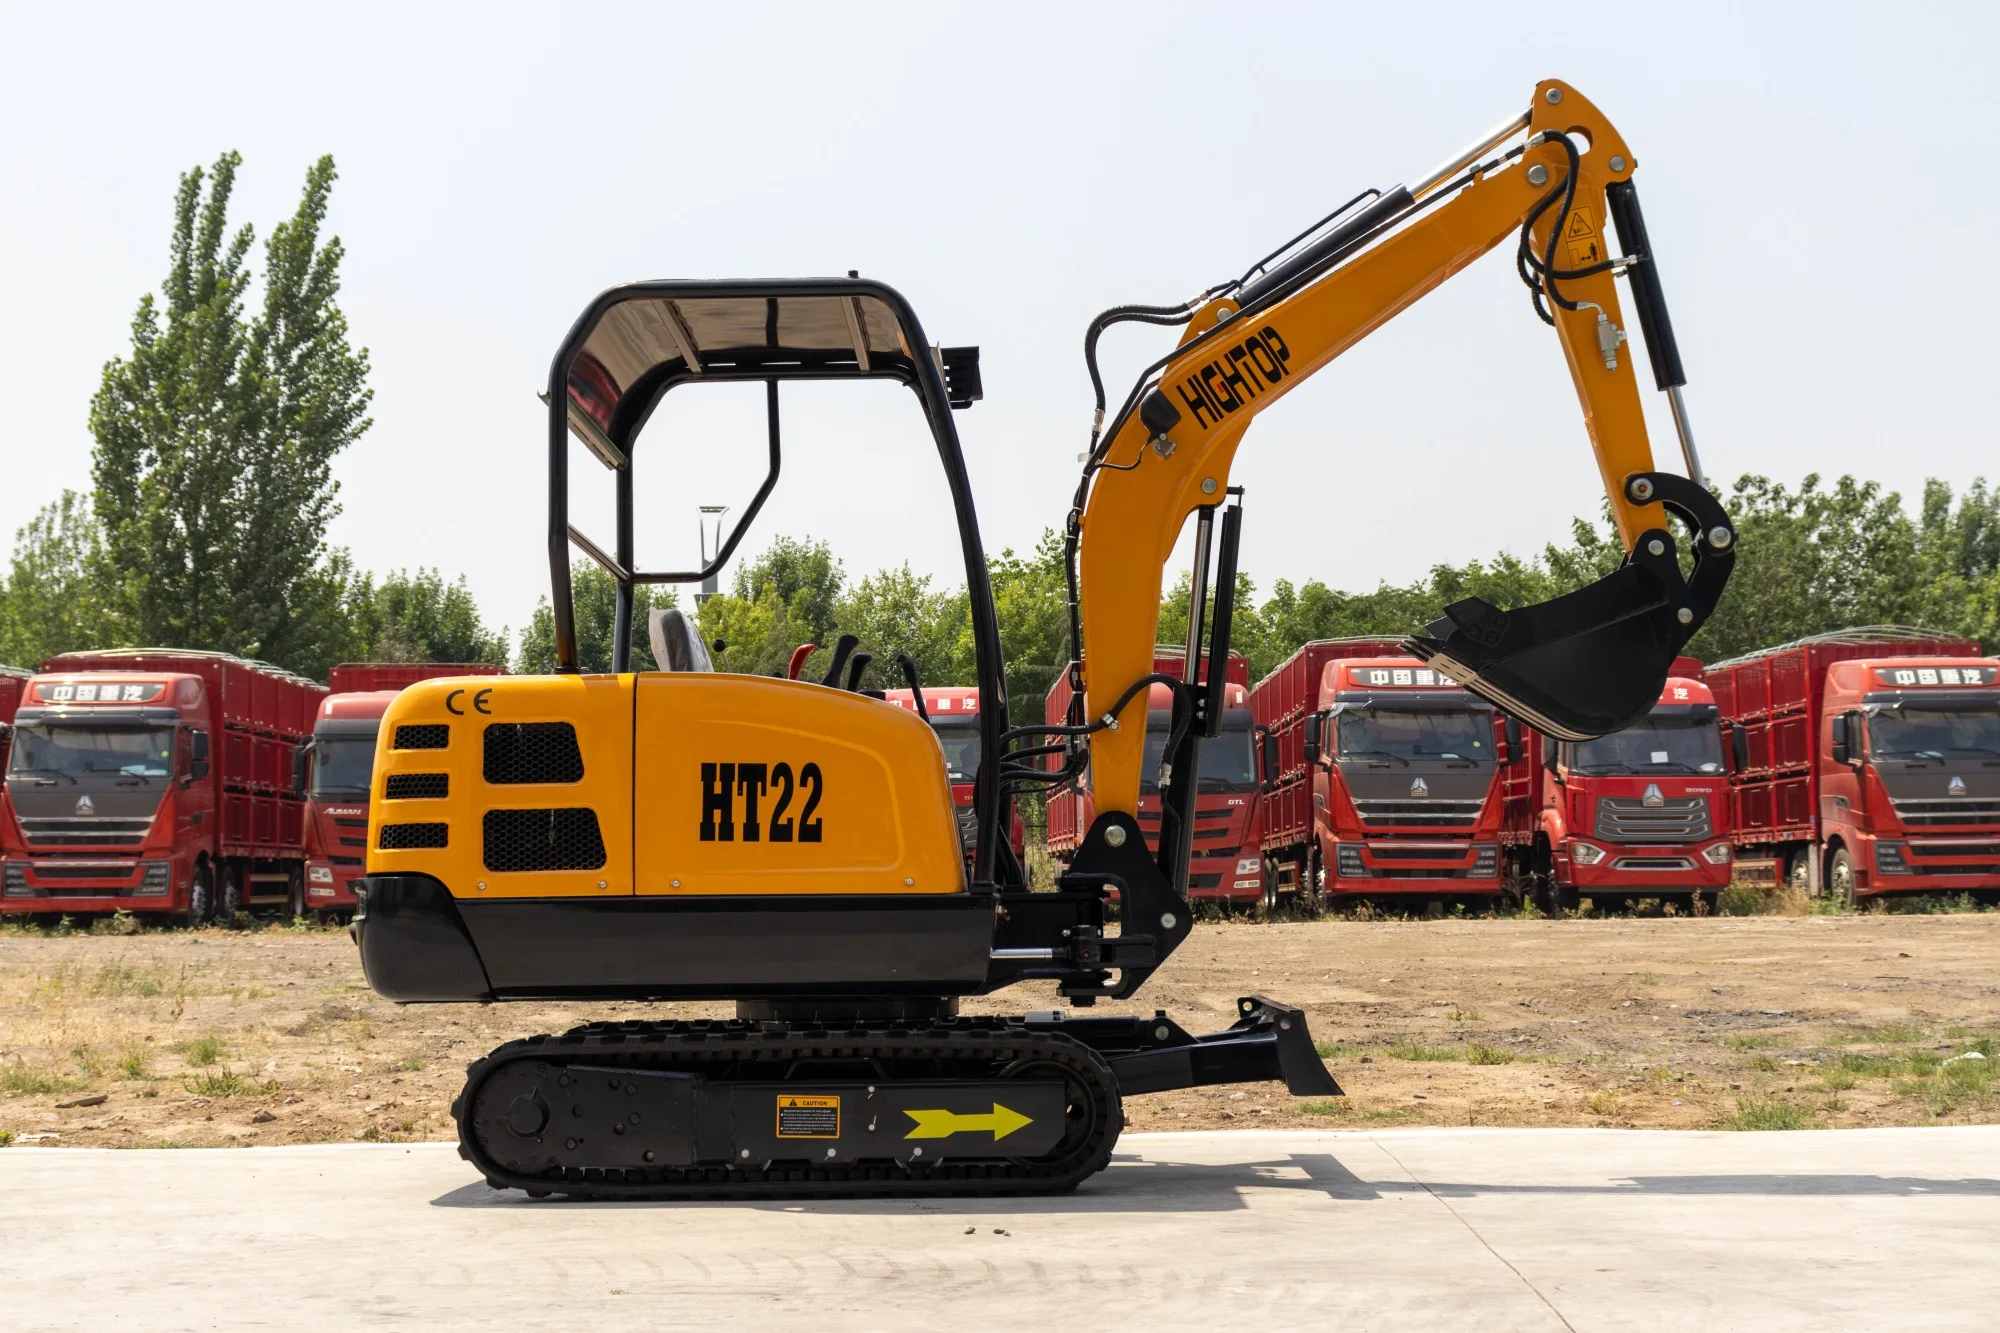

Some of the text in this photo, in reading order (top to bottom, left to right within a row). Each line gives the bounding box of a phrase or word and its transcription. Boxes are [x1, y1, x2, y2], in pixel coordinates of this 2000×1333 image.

[1176, 325, 1291, 430] HIGHTOP
[52, 685, 144, 701] 中国重汽
[1894, 669, 1983, 685] 中国重汽
[700, 762, 823, 842] HT22
